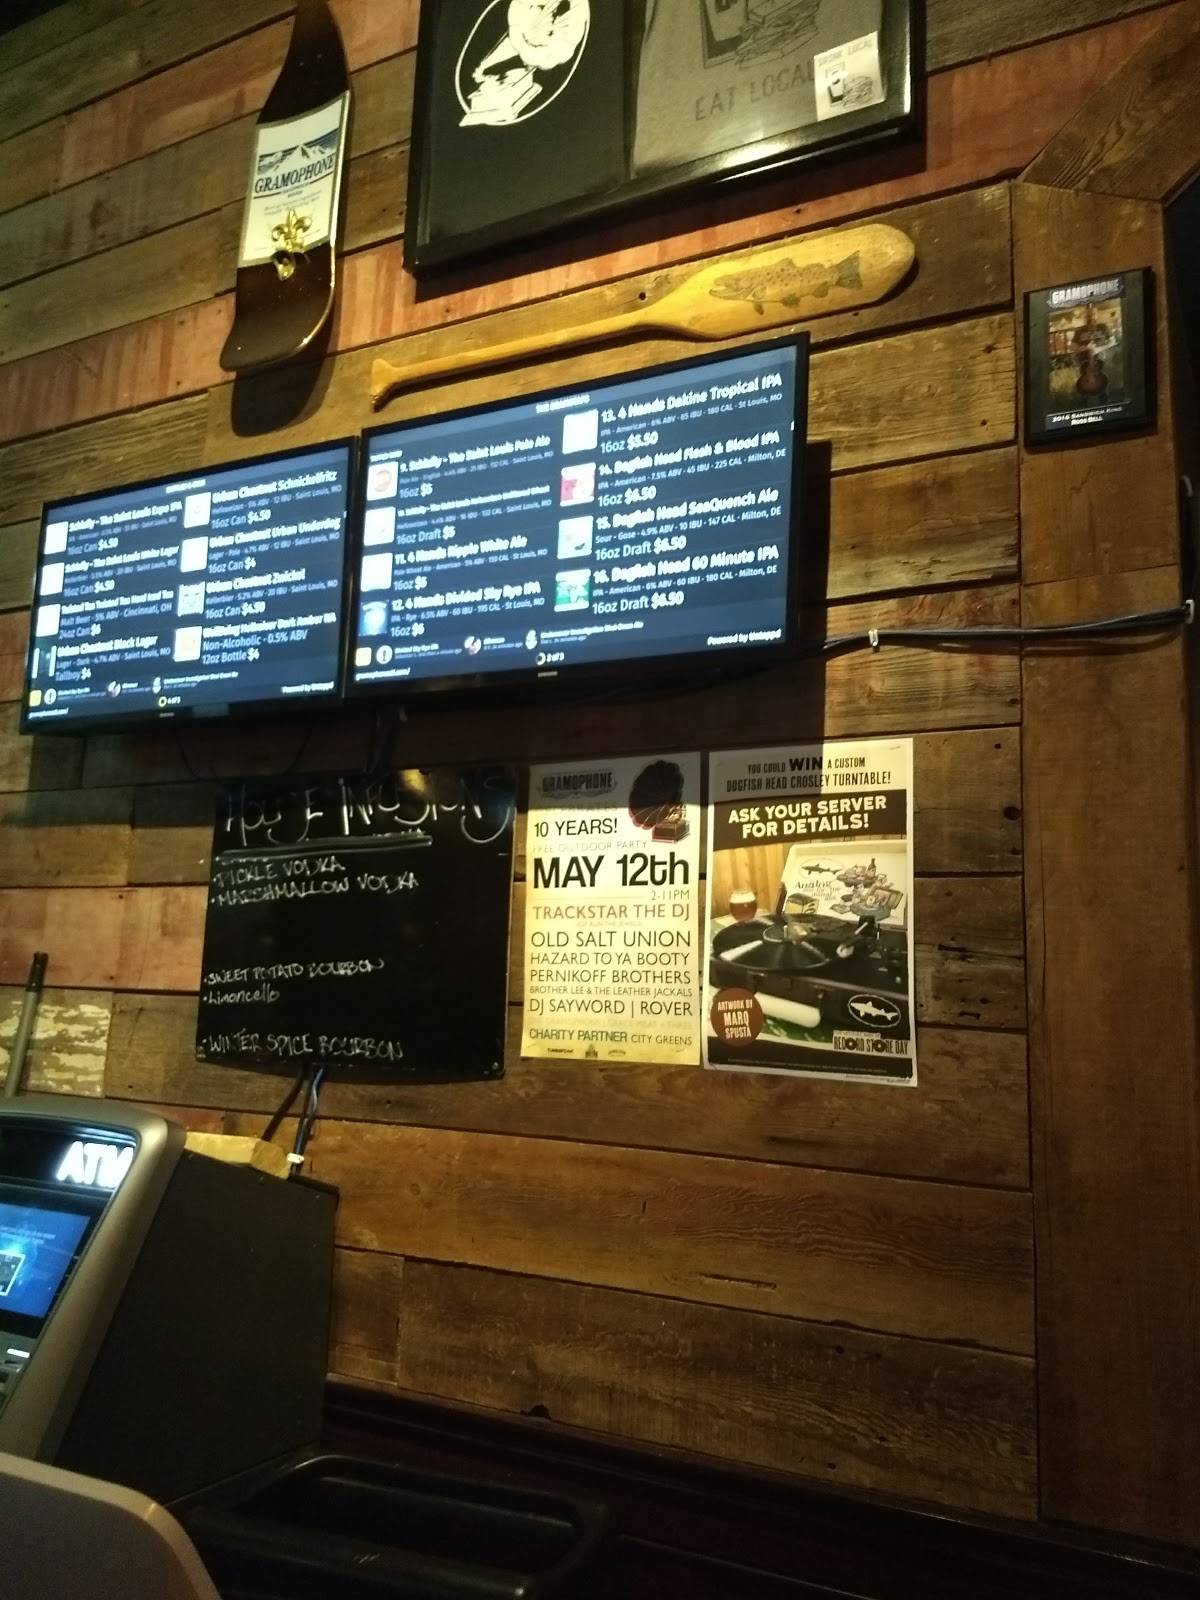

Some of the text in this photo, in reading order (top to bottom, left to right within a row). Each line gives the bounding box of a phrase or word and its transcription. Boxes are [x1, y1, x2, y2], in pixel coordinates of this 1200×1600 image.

[696, 87, 736, 121] EAT
[254, 153, 335, 194] GRAMOPHONE
[1051, 279, 1120, 304] GRAMOPHONE
[628, 398, 666, 418] Hands
[710, 378, 759, 400] Tropical
[762, 372, 782, 389] IPA
[535, 435, 551, 447] Ale
[601, 440, 625, 453] 16oz
[614, 454, 652, 473] Dogfish
[654, 449, 682, 466] Head
[684, 444, 712, 460] Flesh
[726, 434, 759, 453] Blood
[761, 430, 780, 446] IPA
[400, 488, 419, 498] 16oz
[598, 494, 622, 507] 16oz
[612, 508, 655, 528] Dogfish
[656, 502, 687, 520] Head
[688, 492, 756, 515] SeaQuench
[758, 488, 779, 504] Ale
[659, 506, 781, 534] ABV CAL Milton, DE
[397, 528, 441, 544] 16oz Draft
[416, 547, 446, 562] Hands
[510, 535, 528, 549] Ale
[595, 548, 620, 560] 16oz
[622, 541, 651, 557] Draft
[611, 562, 656, 582] Dogfish
[658, 556, 690, 575] Head
[692, 556, 708, 571] 60
[710, 549, 755, 568] Minute
[758, 545, 779, 562] IPA
[394, 580, 413, 591] 16oz
[414, 594, 444, 609] Hands
[592, 602, 617, 614] 16oz
[620, 596, 649, 611] Draft
[203, 630, 308, 650] Non-Alcoholic 0.5% ABV
[391, 627, 411, 636] 16oz
[203, 650, 247, 664] 12oz Bottle
[748, 757, 866, 774] YOU COULD WIN A CUSTOM
[542, 772, 613, 792] GRAMOPHONE
[726, 771, 891, 792] DOGFISH HEAD CROSLEY TURNTABLE!
[728, 795, 887, 824] ASK YOUR SERVER
[534, 818, 618, 837] 10 YEARS!
[742, 813, 869, 839] FOR DETAILS!
[559, 841, 612, 852] OUTDOOR
[617, 840, 647, 849] PARTY
[533, 852, 689, 889] MAY 12th
[532, 904, 690, 921] TRACKSTAR THE DJ
[531, 930, 690, 947] OLD SALT UNION
[530, 952, 690, 966] HAZARD TO YA BOOTY
[207, 968, 250, 985] SWEET
[530, 970, 690, 984] PERNIKOFF BROTHERS
[530, 986, 692, 998] BROTHER LEE & THE LEATHER JACKALS
[530, 999, 693, 1016] DJ SAYWORD ROVER
[718, 1000, 744, 1011] ARTWORK
[723, 1011, 749, 1026] MARQ
[530, 1028, 692, 1046] CHARITY PARTNER CITY GREENS
[834, 1036, 908, 1055] RECORD STORE DAY
[267, 1033, 313, 1056] SPICE
[318, 1035, 403, 1060] BOURBON
